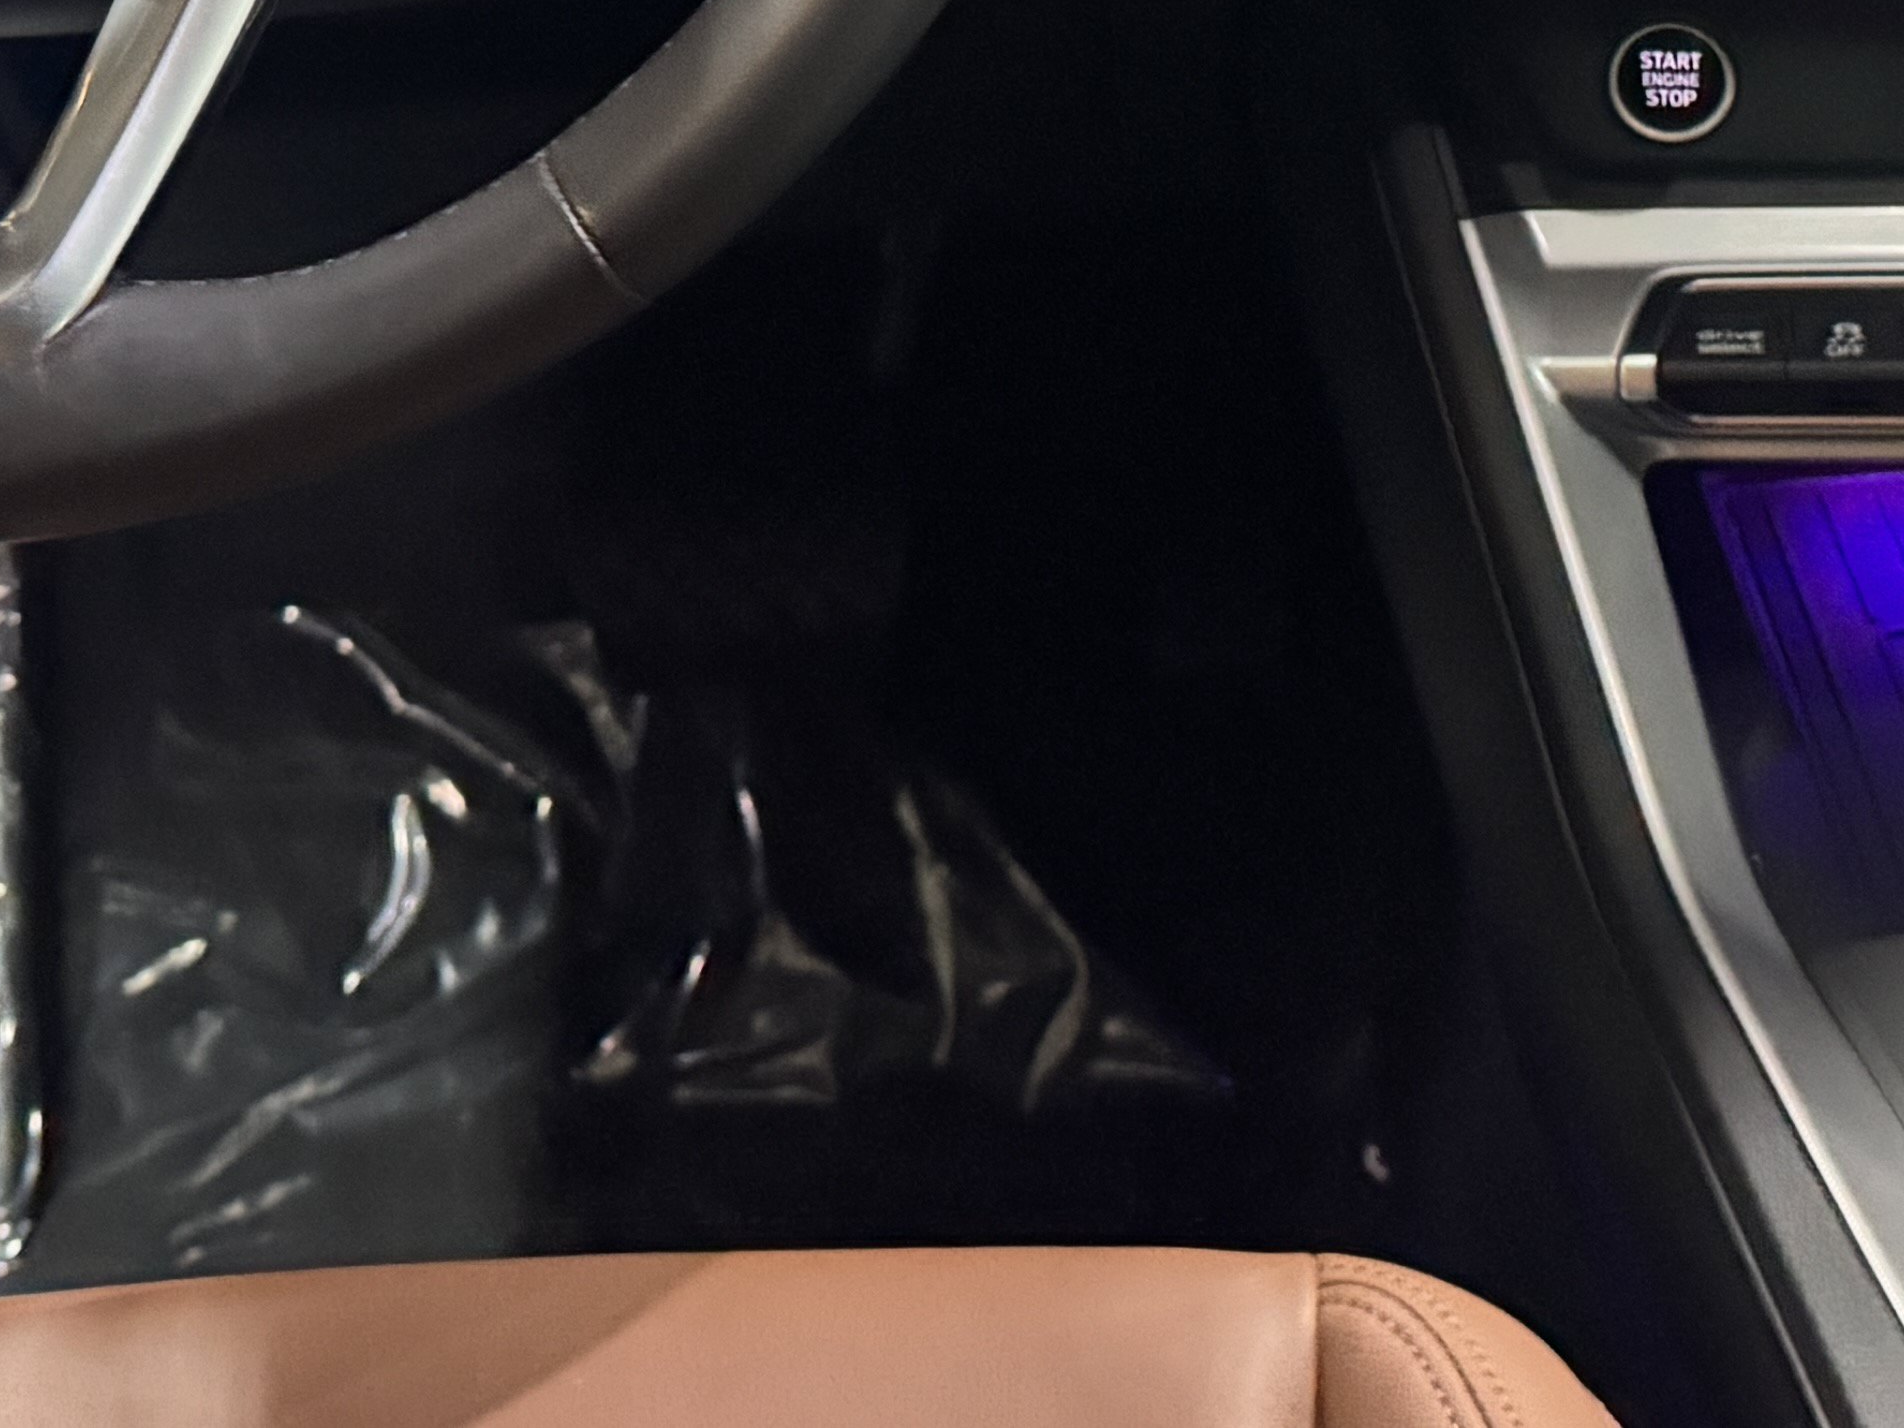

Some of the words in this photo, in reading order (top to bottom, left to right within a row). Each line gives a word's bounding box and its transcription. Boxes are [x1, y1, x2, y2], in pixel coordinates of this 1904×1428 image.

[1639, 50, 1703, 70] START
[1641, 71, 1701, 88] ENGINE
[1645, 88, 1698, 107] STOP
